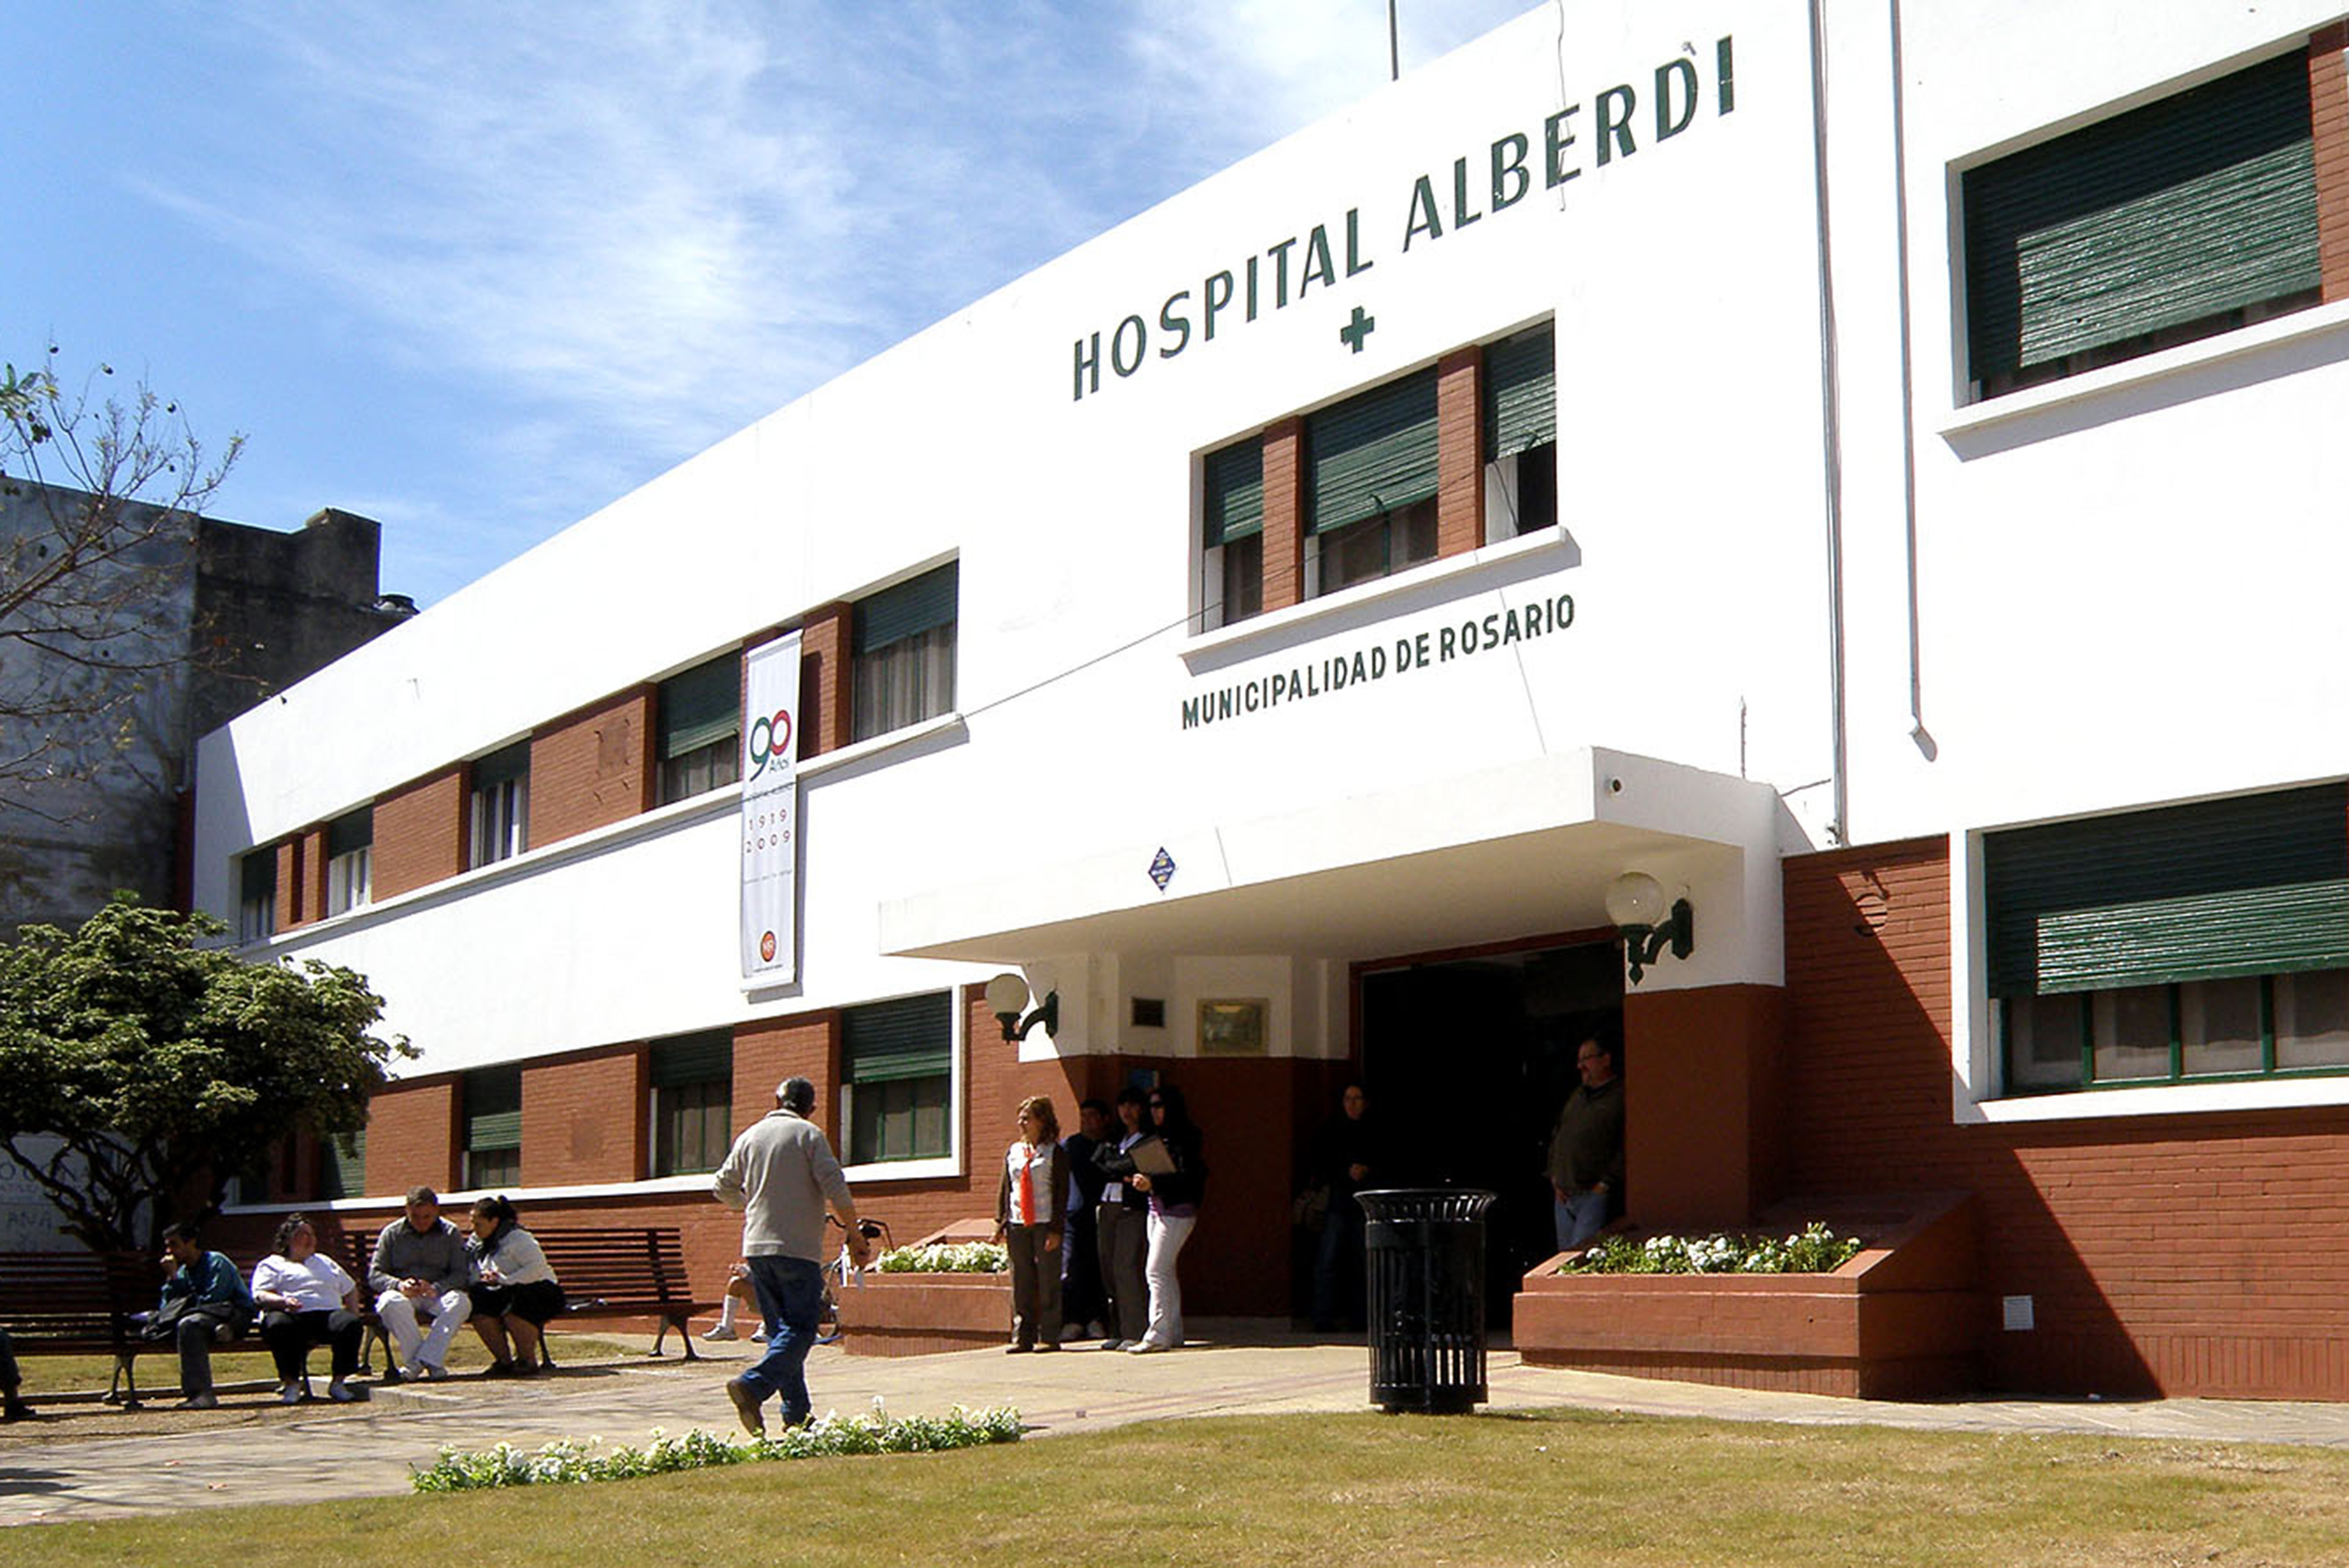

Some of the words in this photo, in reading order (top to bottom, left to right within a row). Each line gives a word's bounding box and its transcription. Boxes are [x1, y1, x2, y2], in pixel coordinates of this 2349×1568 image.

[1074, 208, 1373, 401] HOSPITAL
[1403, 35, 1734, 253] ALBERDI
[1182, 646, 1386, 730] MUNICIPALIDAD
[1397, 633, 1429, 673] DE
[1440, 595, 1574, 662] ROSARIO
[750, 710, 791, 782] 90
[746, 830, 791, 854] 2009
[749, 808, 787, 830] 1919
